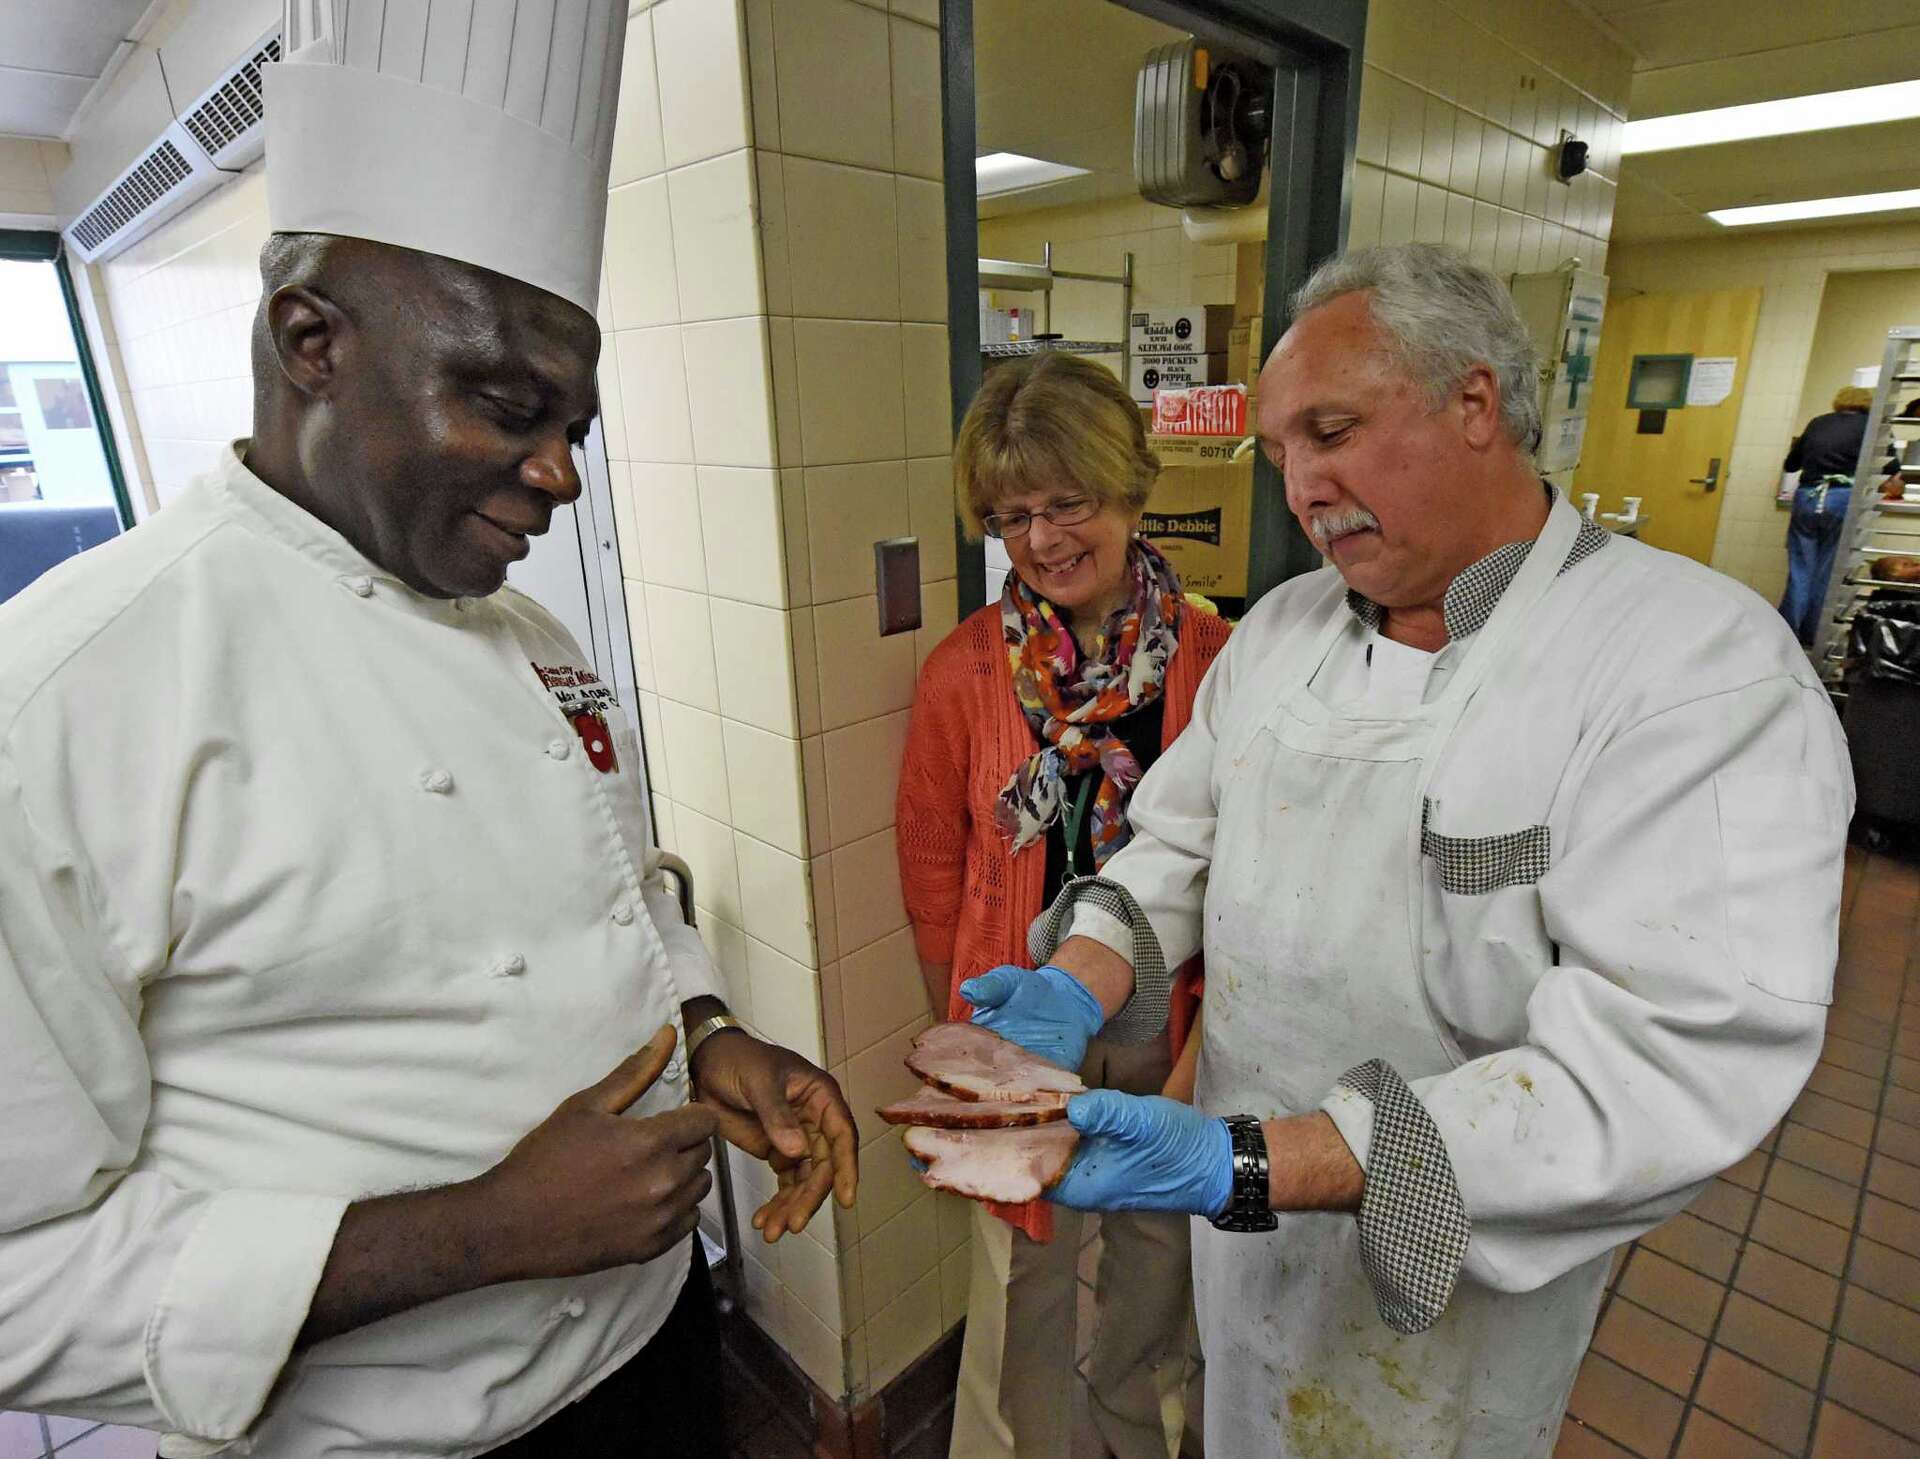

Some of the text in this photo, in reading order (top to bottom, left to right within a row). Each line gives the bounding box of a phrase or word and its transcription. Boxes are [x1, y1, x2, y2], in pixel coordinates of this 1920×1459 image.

[1138, 343, 1172, 352] PACKETS
[1162, 356, 1198, 365] PACKETS
[1160, 373, 1192, 382] PEPPER
[1138, 519, 1216, 533] ittle Debbie
